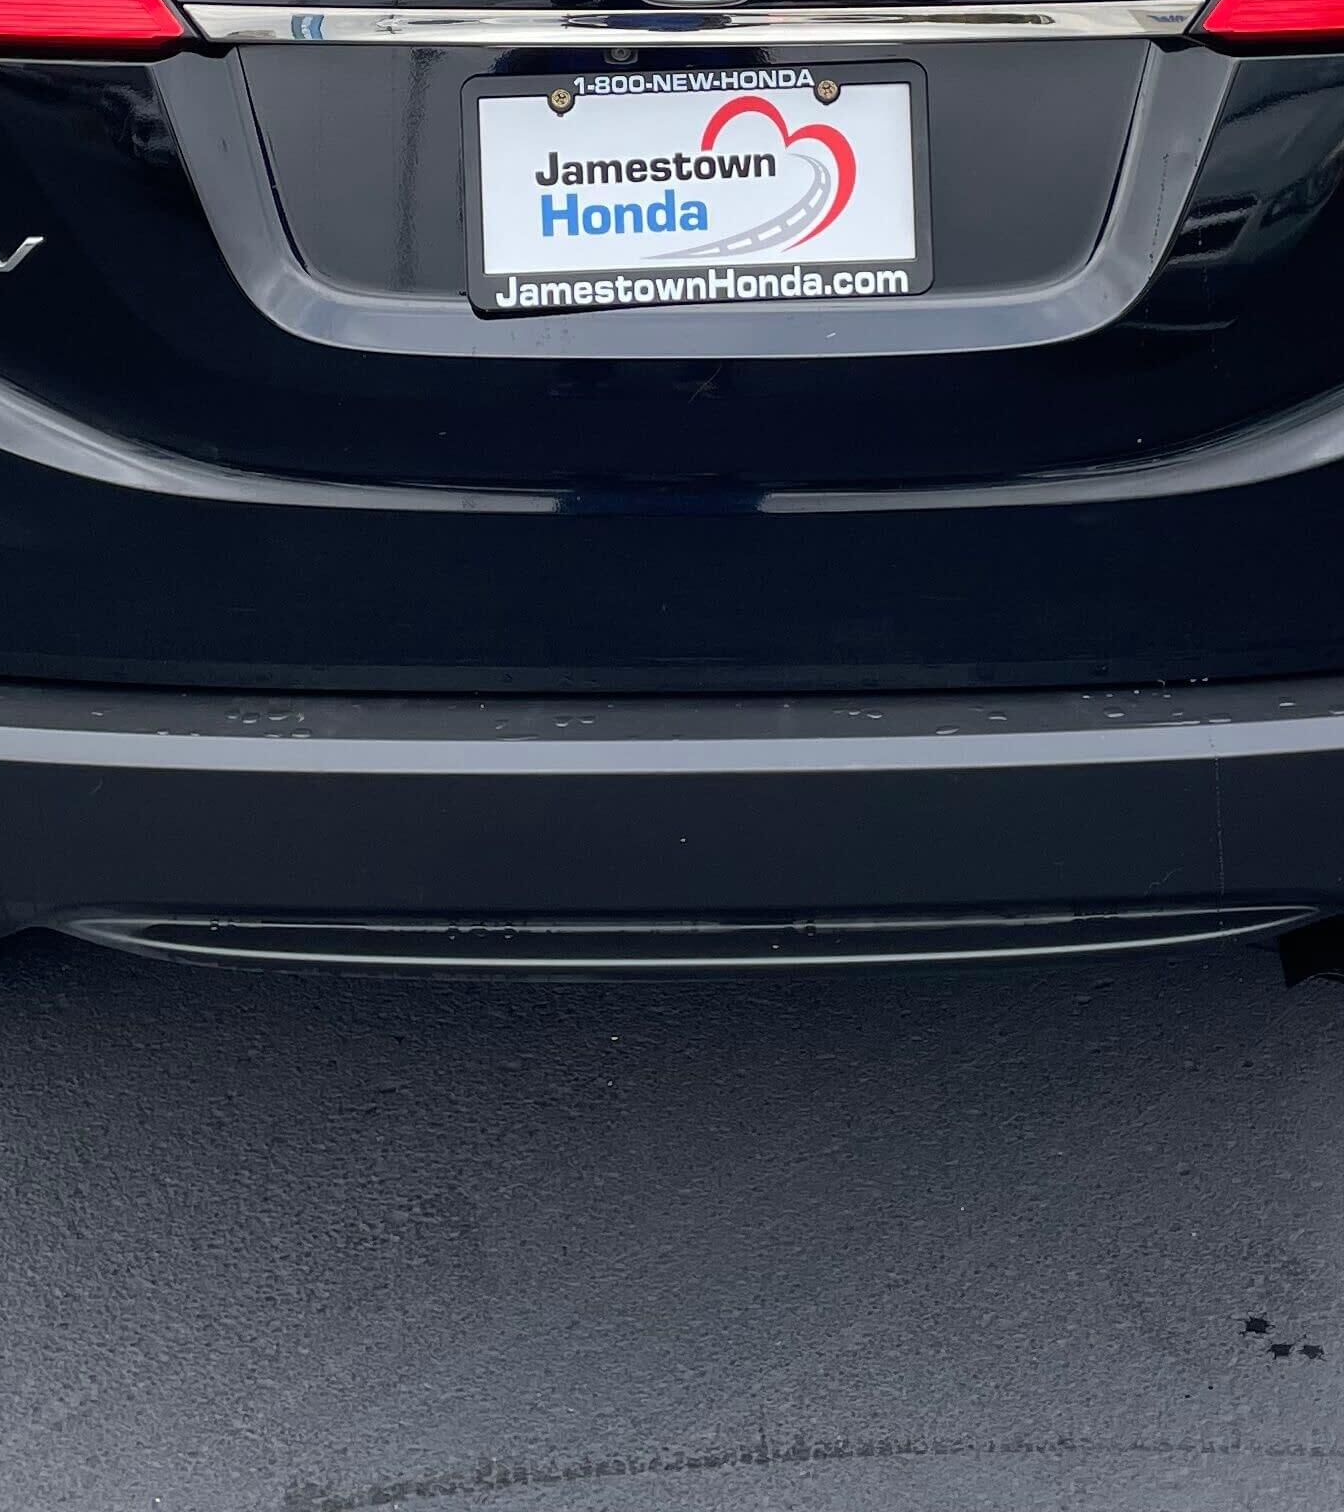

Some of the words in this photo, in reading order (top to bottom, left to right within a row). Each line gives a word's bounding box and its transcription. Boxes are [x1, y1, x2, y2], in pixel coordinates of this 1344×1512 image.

[573, 68, 816, 96] 1-800-NEW-HONDA
[535, 150, 777, 187] Jamestown
[540, 189, 709, 237] Honda
[495, 265, 910, 308] JamestownHonda.com
